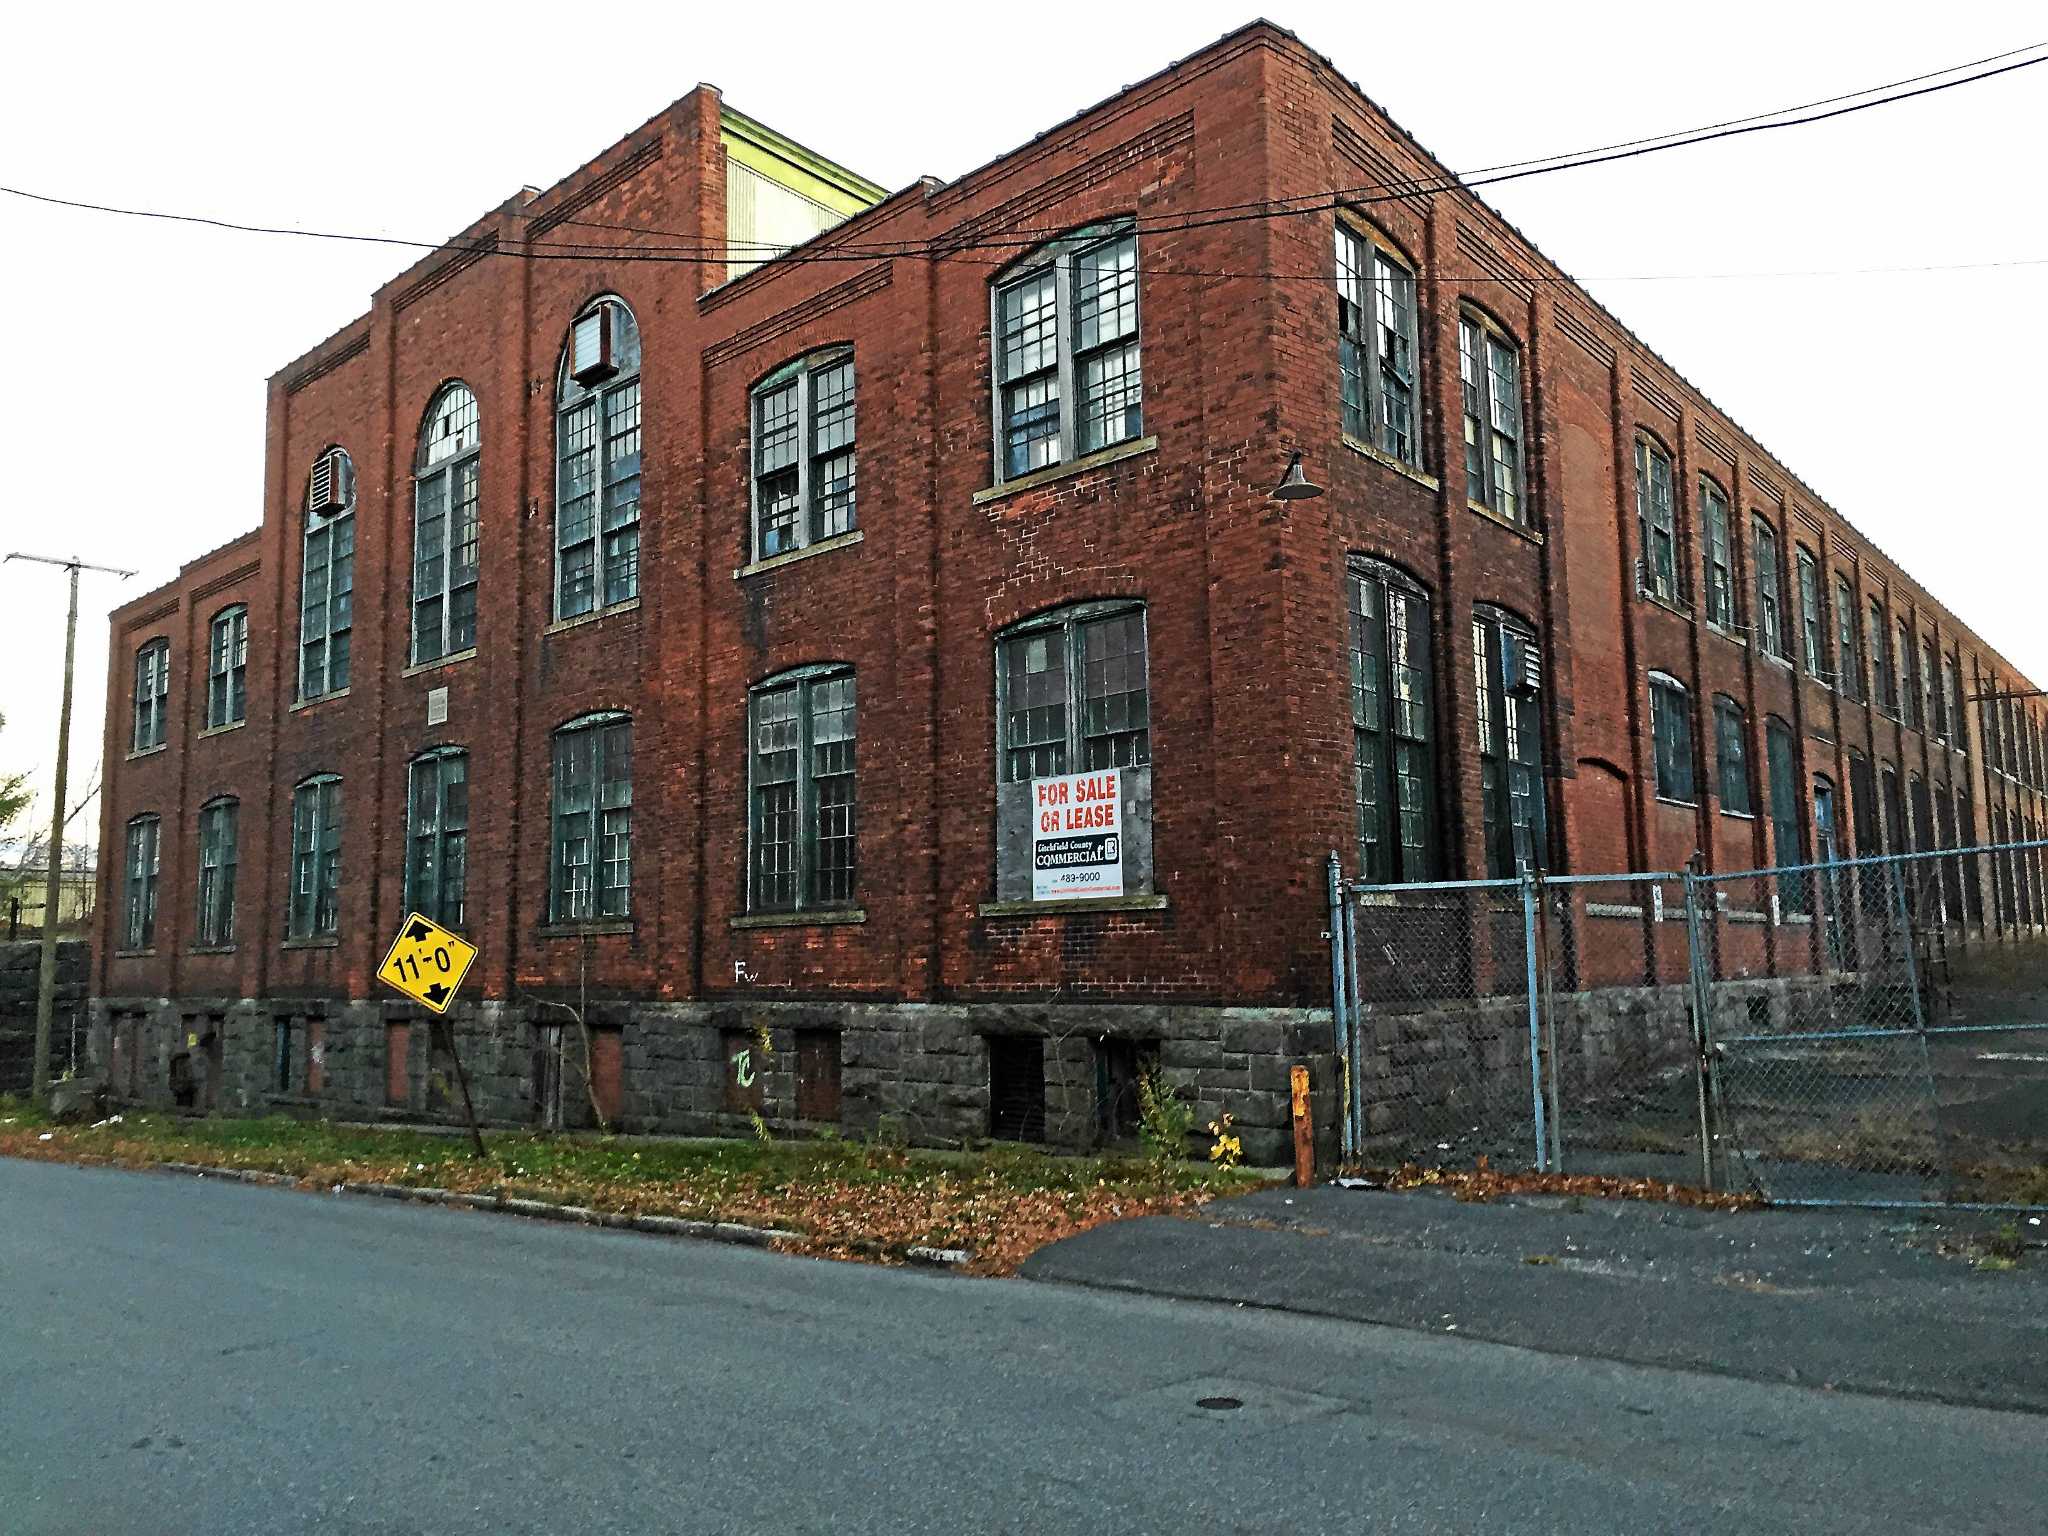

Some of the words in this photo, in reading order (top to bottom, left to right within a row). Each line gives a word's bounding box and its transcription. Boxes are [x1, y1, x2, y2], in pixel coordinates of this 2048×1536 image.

[1038, 782, 1069, 807] FOR
[1076, 775, 1116, 803] SALE
[1040, 810, 1060, 832] OR
[1066, 804, 1114, 829] LEASE
[1036, 850, 1104, 867] COMMERCIAL
[1061, 871, 1100, 883] 489-9000
